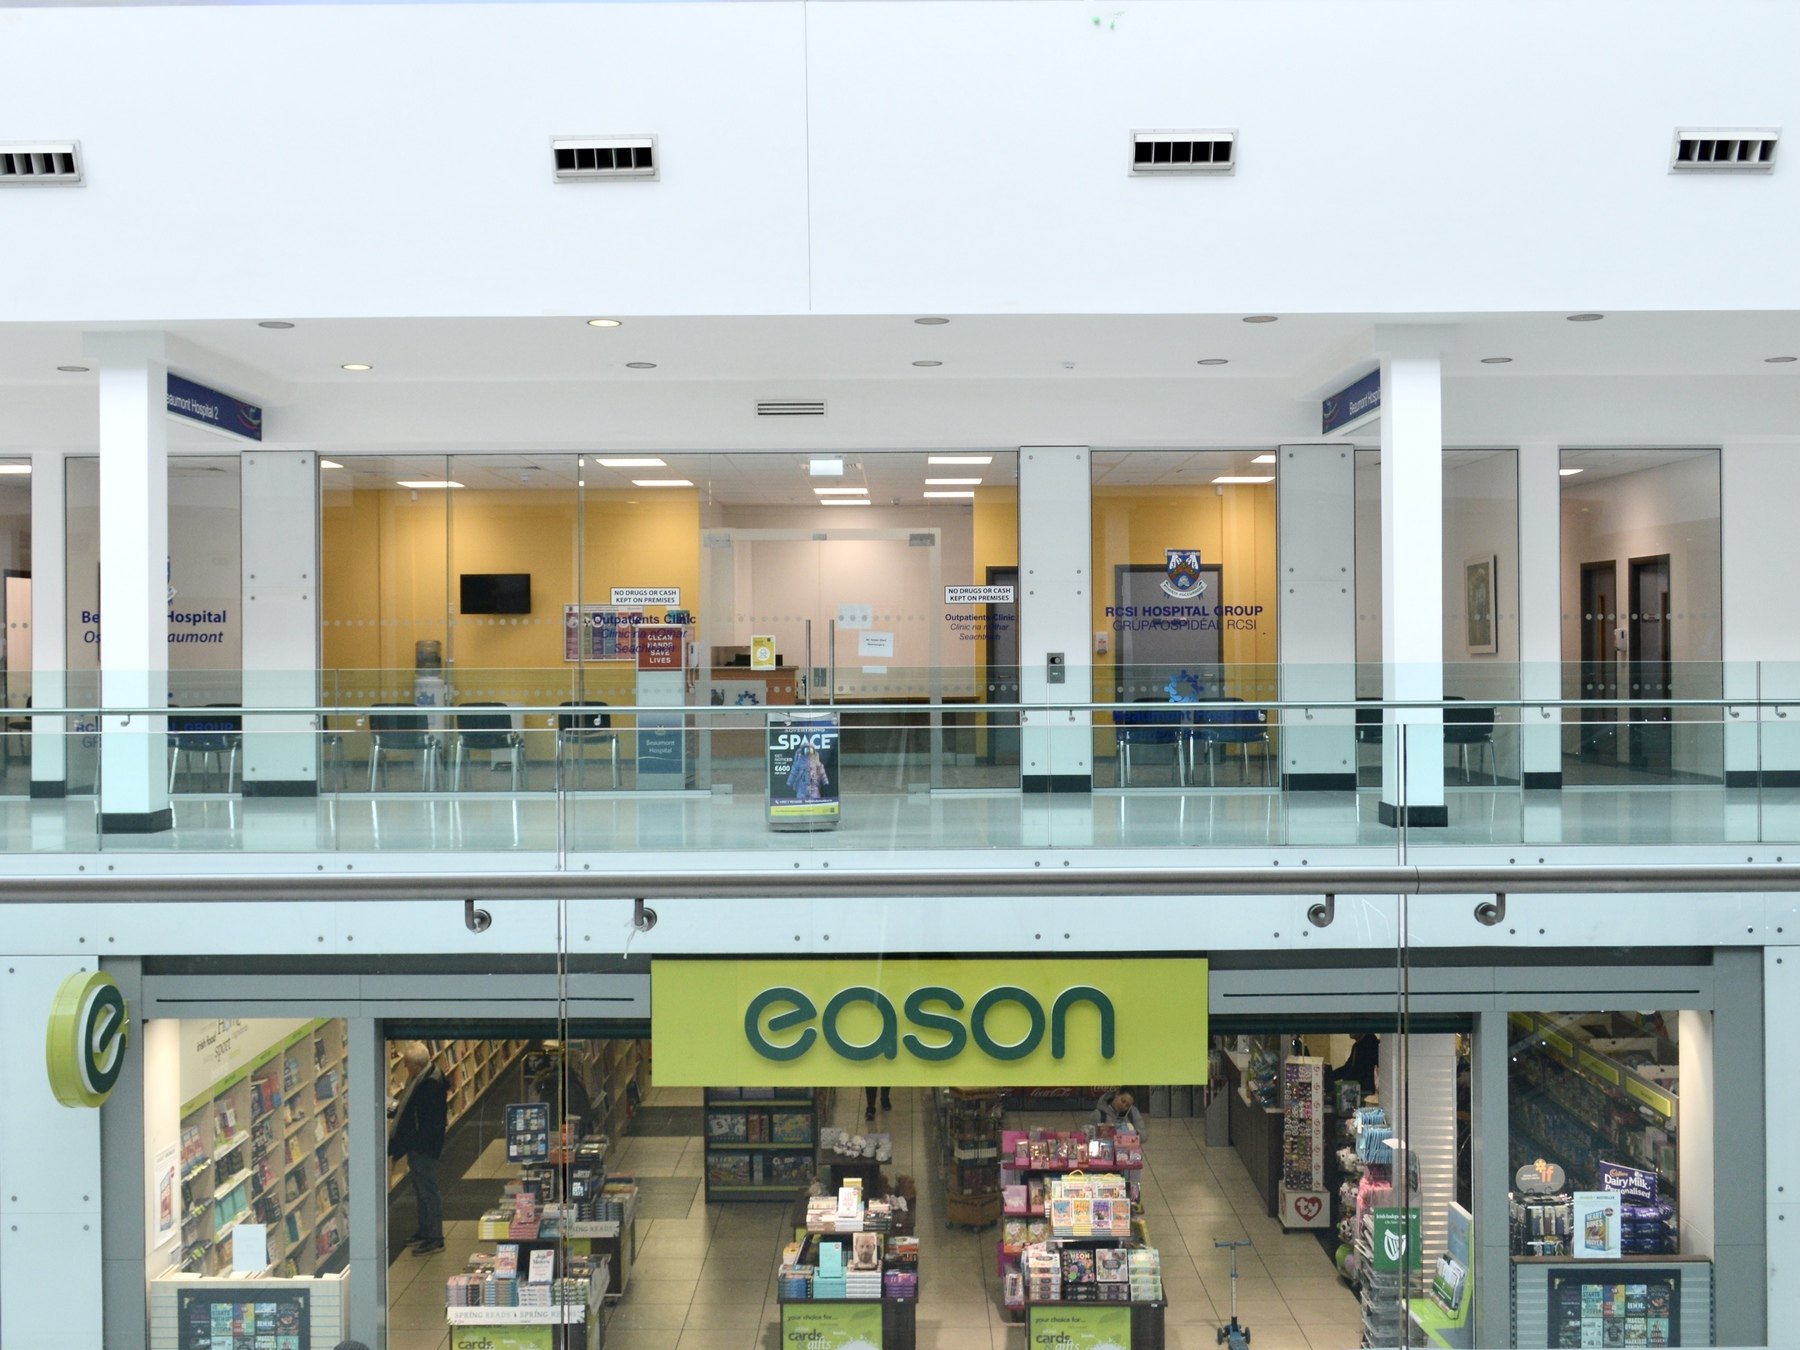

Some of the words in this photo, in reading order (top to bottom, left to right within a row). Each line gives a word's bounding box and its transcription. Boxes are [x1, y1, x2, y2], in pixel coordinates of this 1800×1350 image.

[167, 394, 191, 412] eaumont
[191, 399, 213, 419] Hospital
[214, 406, 219, 420] 2
[168, 611, 226, 625] Hospital
[945, 613, 990, 621] Outpatients
[993, 613, 1015, 621] Clinic
[1106, 607, 1138, 617] RCSI
[1143, 606, 1209, 617] HOSPITAL
[1214, 606, 1263, 616] GROUP
[593, 613, 660, 625] Outpatients
[663, 613, 697, 624] Clinic
[1160, 616, 1222, 630] OSPIDÉAL
[1227, 619, 1256, 630] RCSI
[168, 631, 223, 643] aumont
[601, 629, 630, 638] Clinic
[771, 734, 837, 750] SPACE
[744, 986, 1115, 1062] eason
[81, 984, 126, 1094] e
[1541, 1166, 1554, 1183] if
[1604, 1174, 1628, 1188] Dairy
[1605, 1184, 1651, 1198] Personalised
[1297, 1199, 1319, 1217] ty
